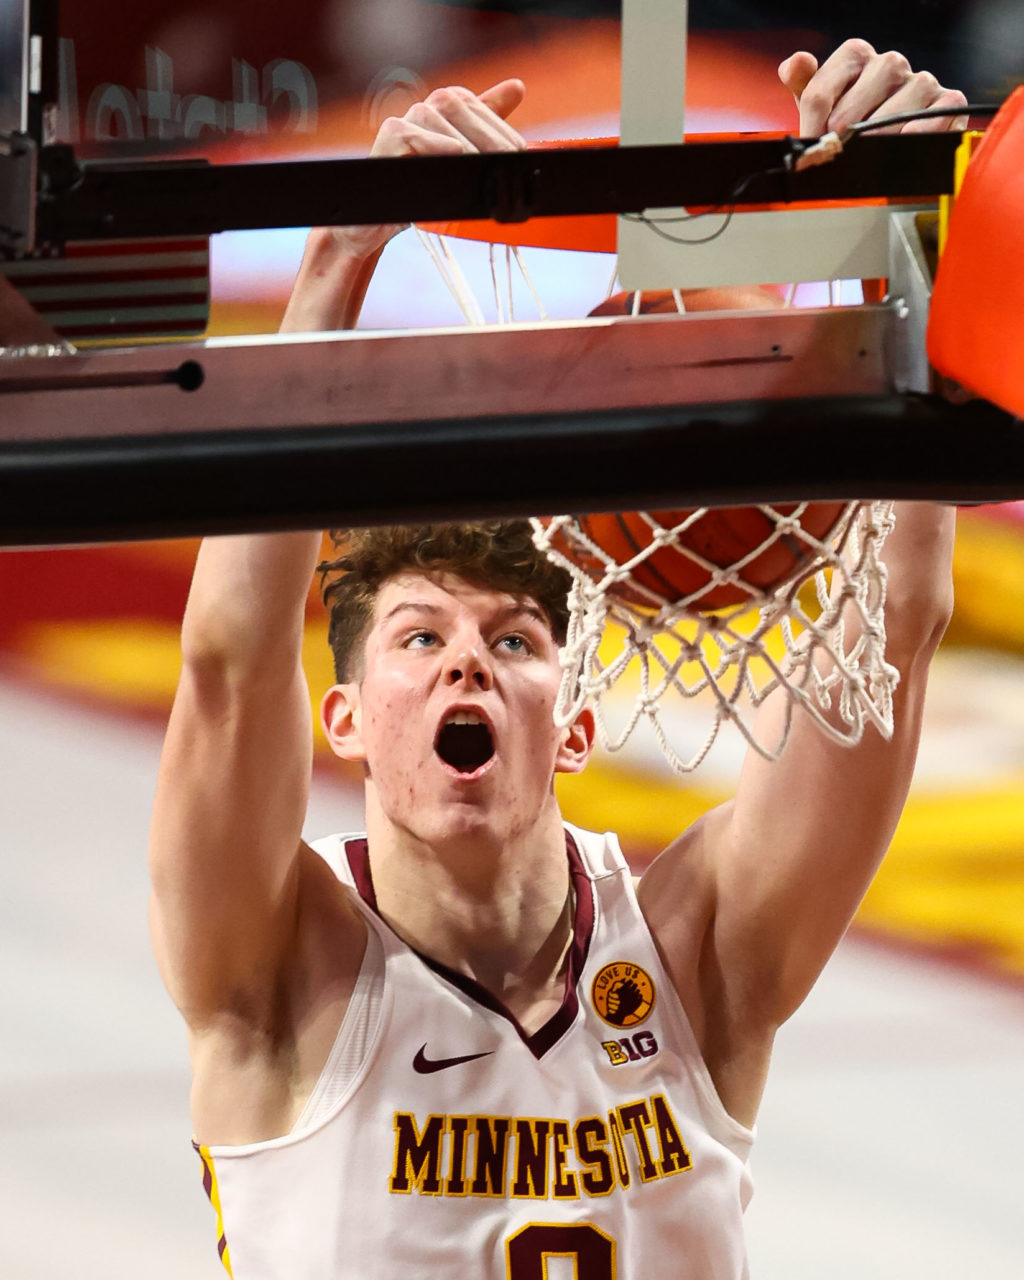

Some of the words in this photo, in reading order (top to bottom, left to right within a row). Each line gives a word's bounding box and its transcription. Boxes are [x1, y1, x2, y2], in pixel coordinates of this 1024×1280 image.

[596, 967, 620, 990] LOVE
[624, 966, 640, 979] US
[389, 1093, 693, 1200] MINNESOTA
